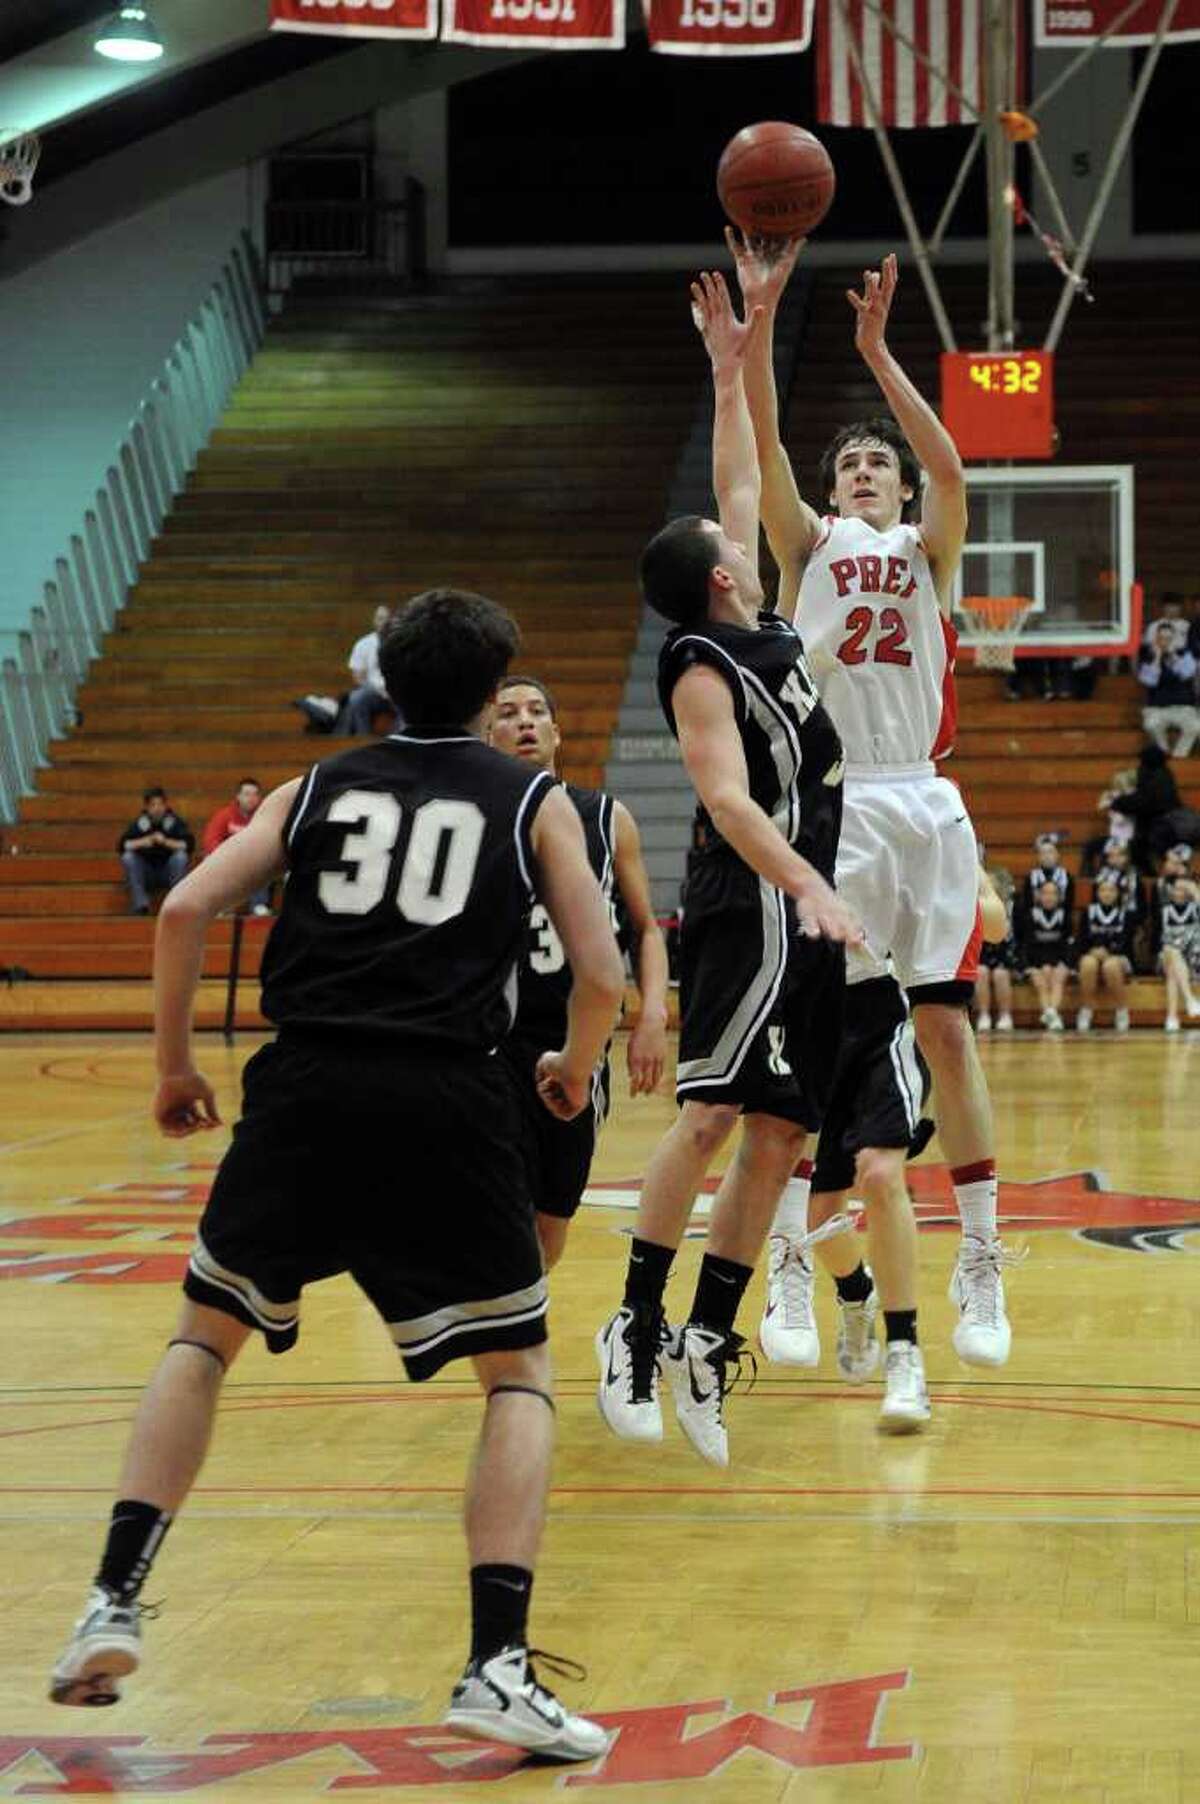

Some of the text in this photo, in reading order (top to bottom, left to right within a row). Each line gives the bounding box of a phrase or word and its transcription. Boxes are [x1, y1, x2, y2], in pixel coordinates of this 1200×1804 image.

[970, 361, 1042, 394] 4:32
[836, 606, 913, 667] 22
[318, 788, 487, 926] 30
